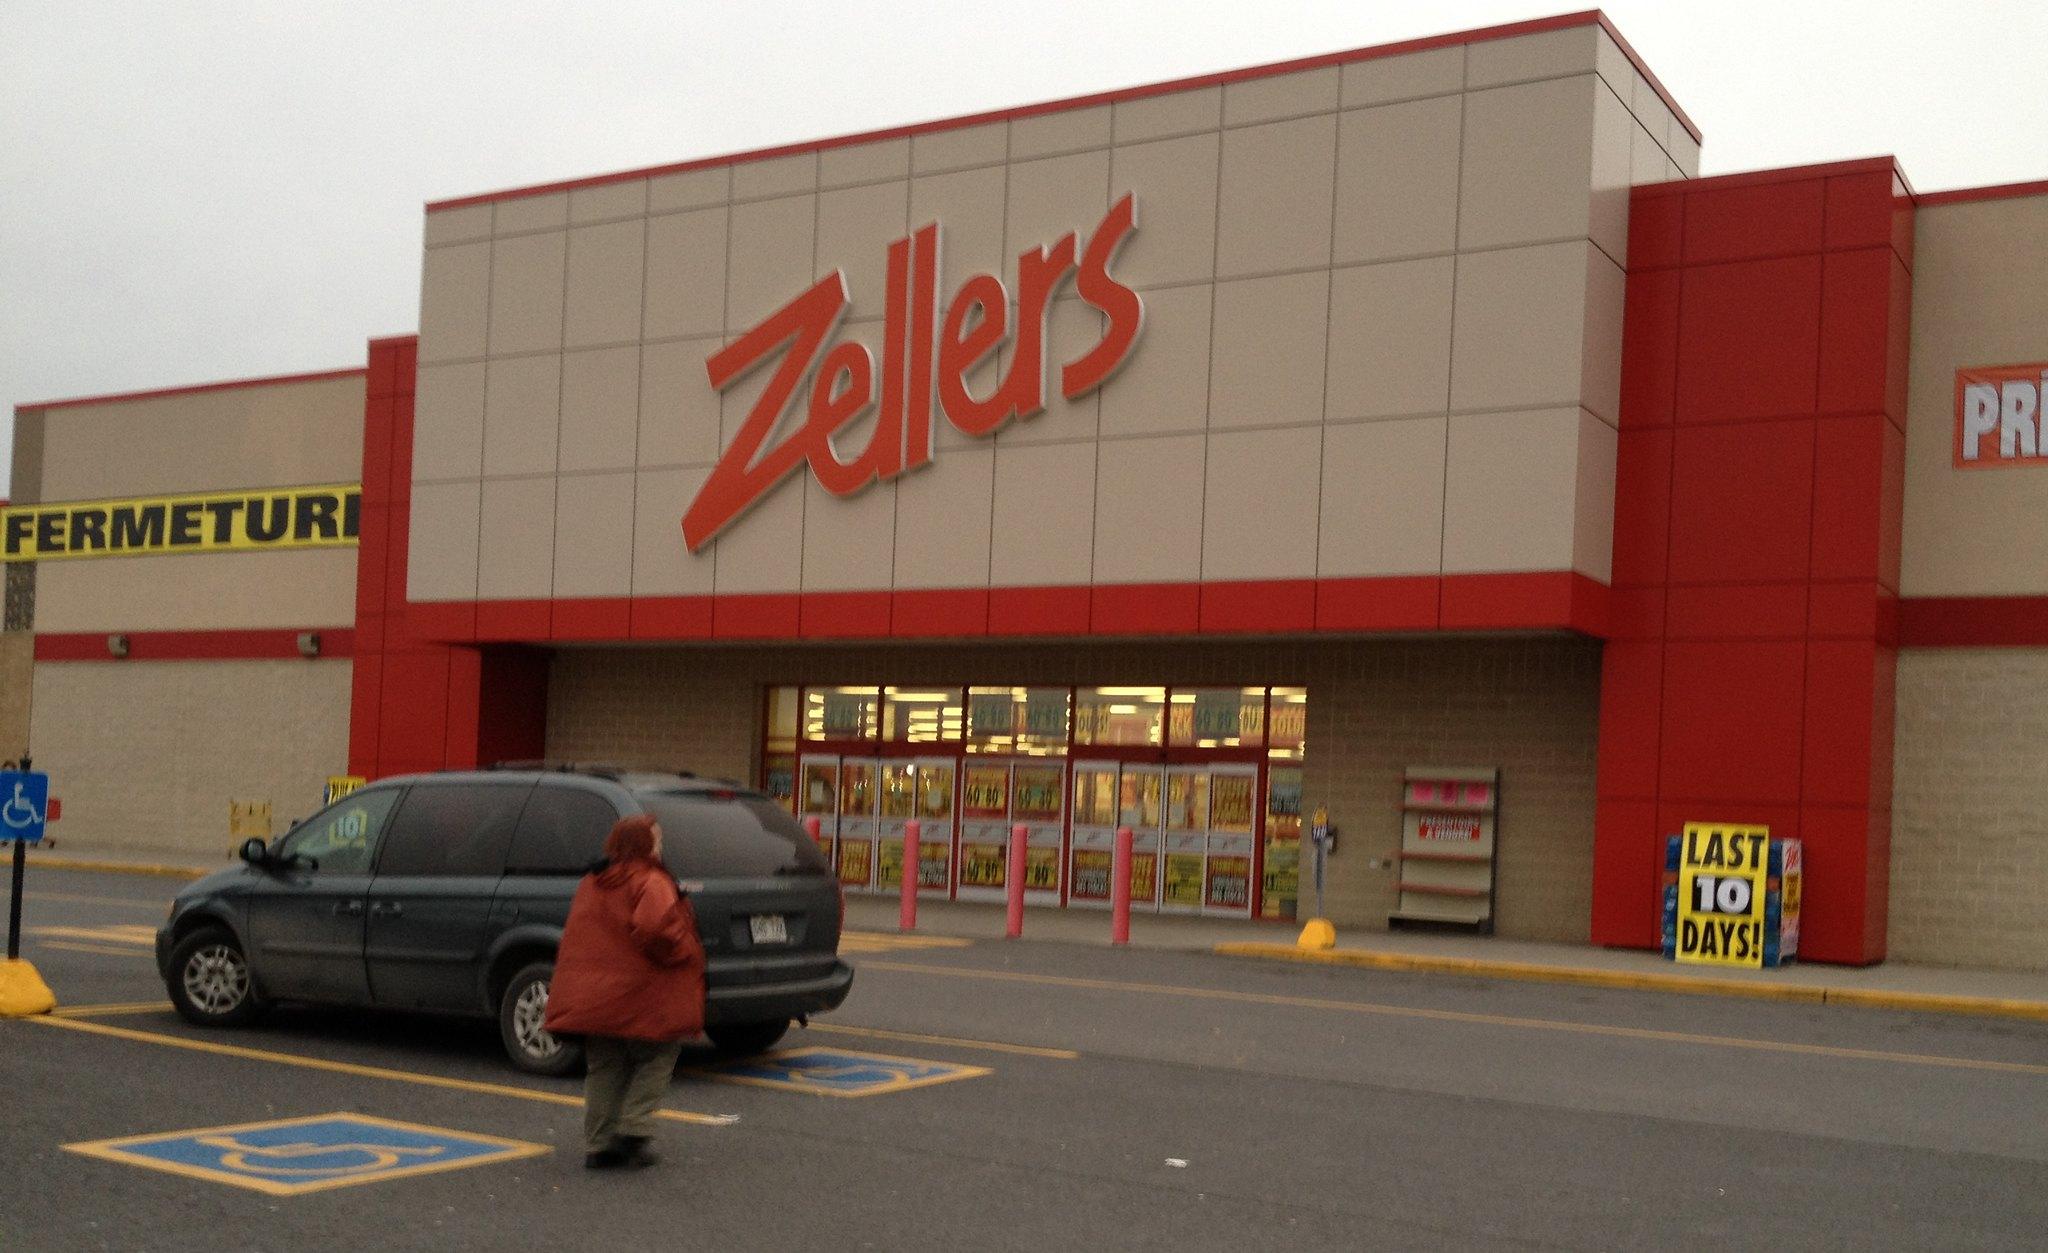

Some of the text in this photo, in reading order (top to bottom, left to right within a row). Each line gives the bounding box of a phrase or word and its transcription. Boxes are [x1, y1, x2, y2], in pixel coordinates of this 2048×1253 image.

[681, 190, 1145, 554] Zellers
[1687, 831, 1765, 868] LAST
[1697, 873, 1751, 914] 10
[1682, 919, 1760, 959] DAYS!
